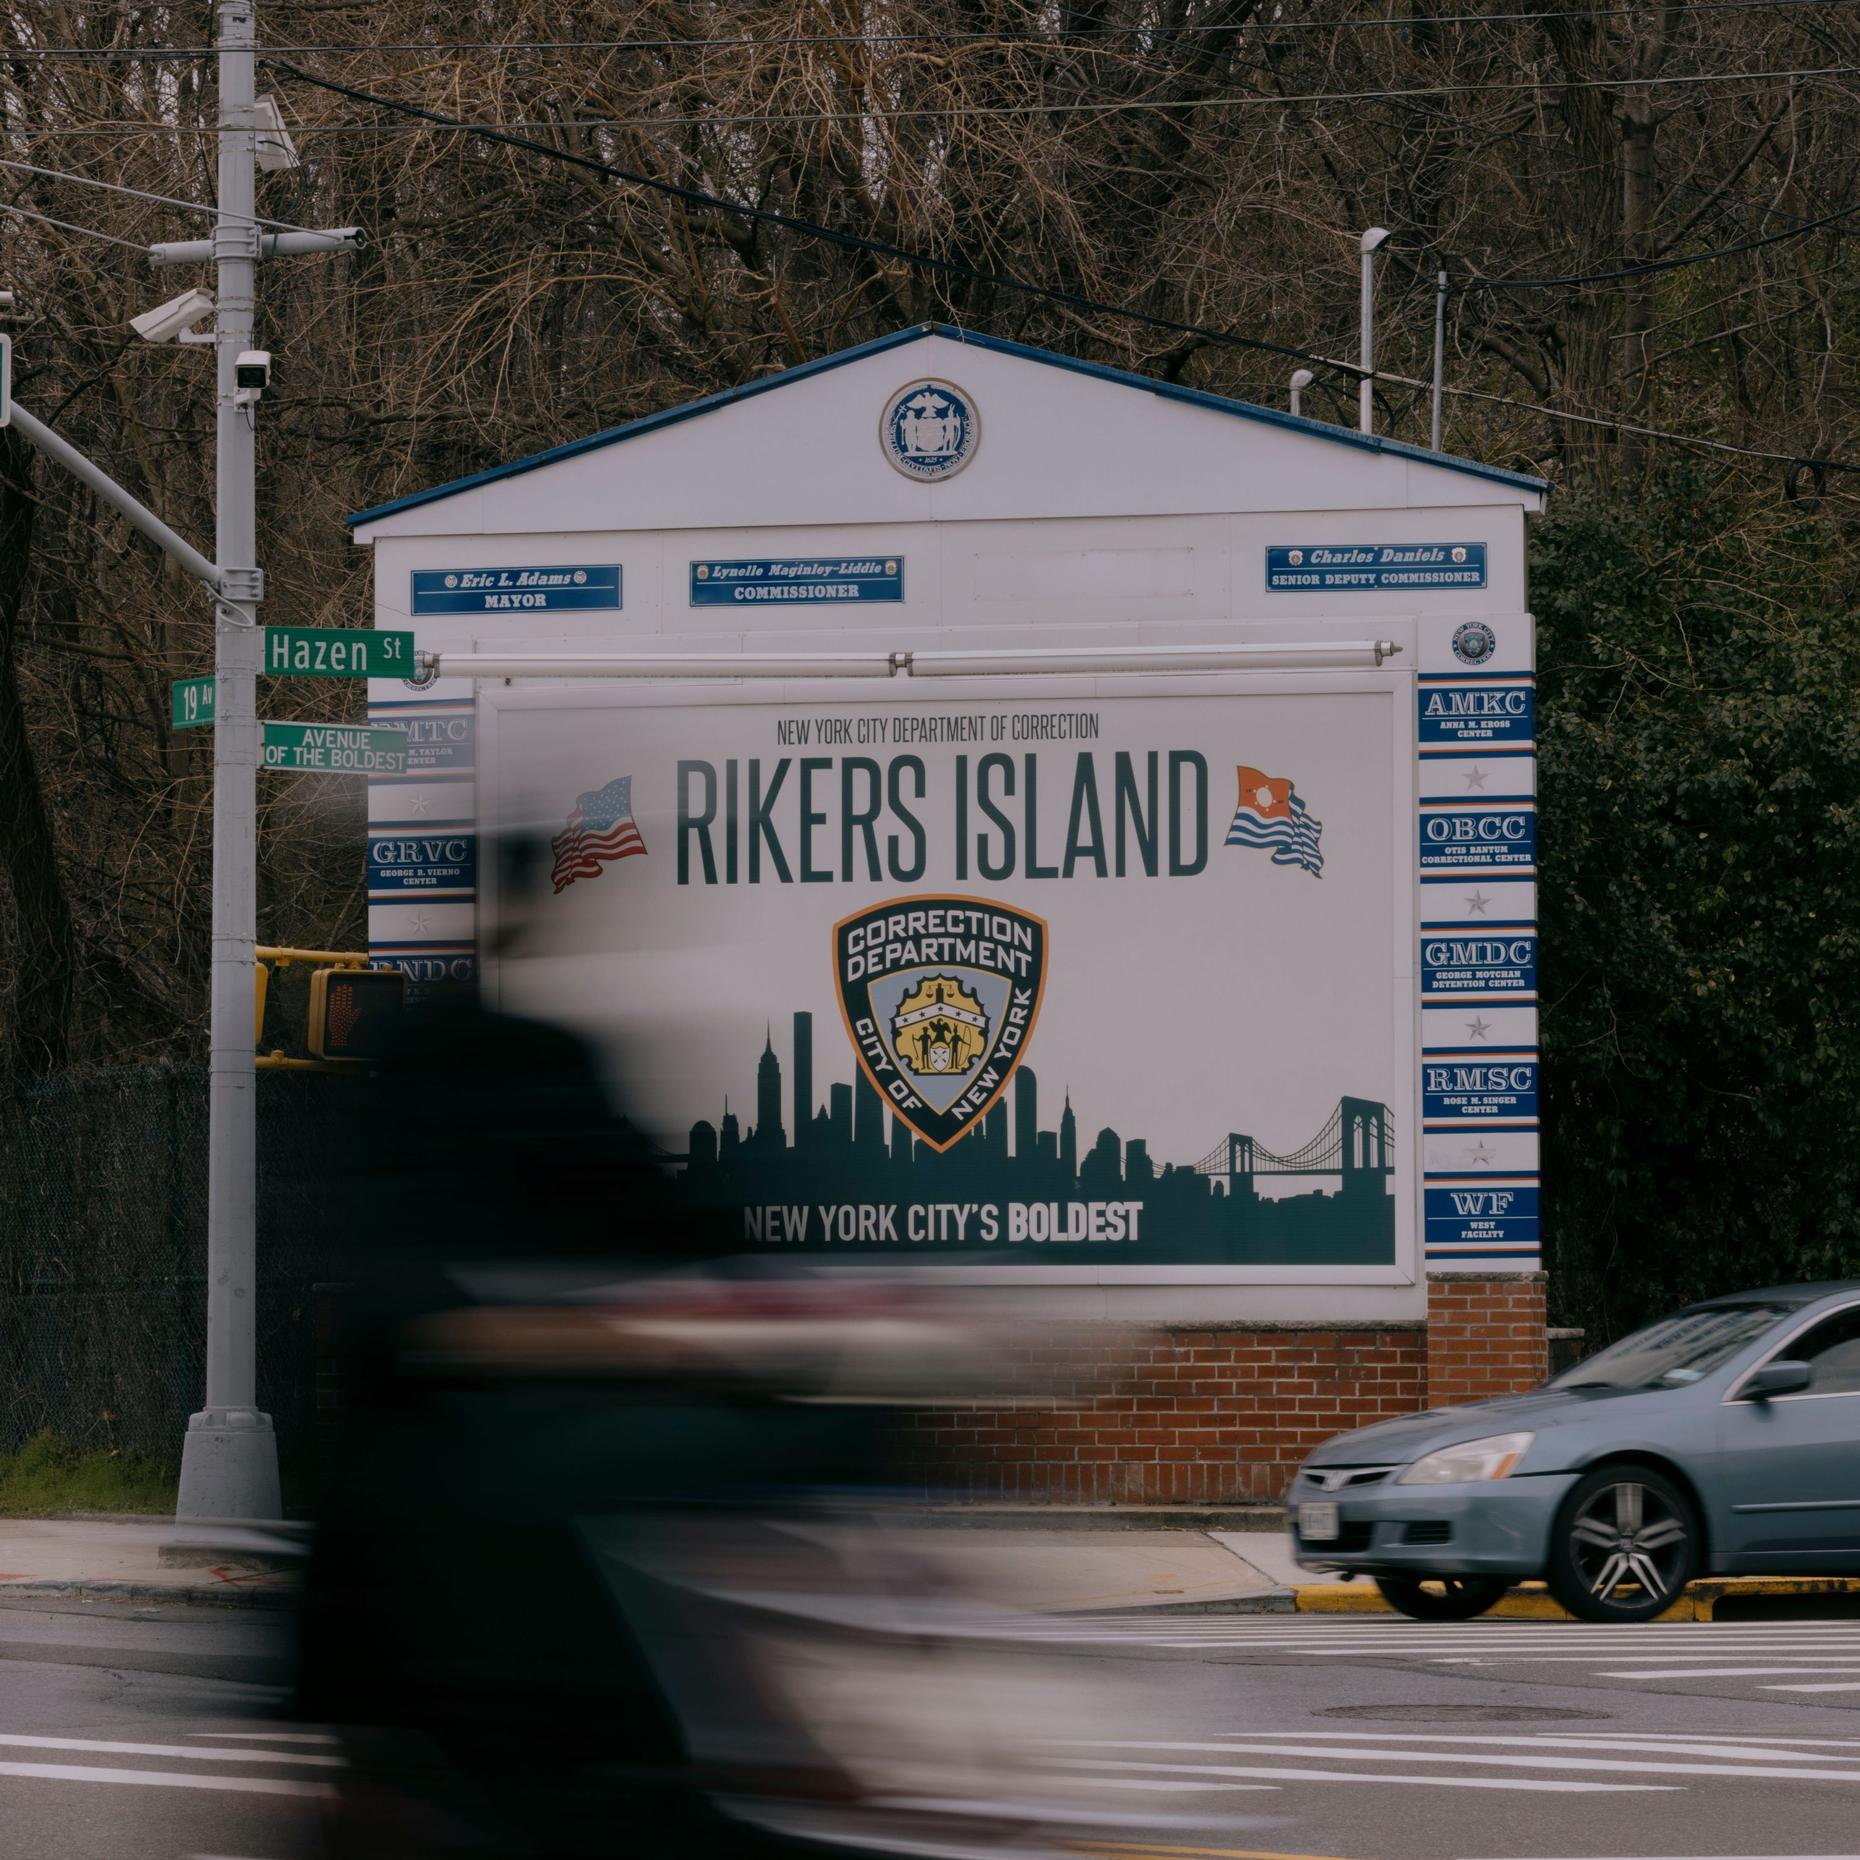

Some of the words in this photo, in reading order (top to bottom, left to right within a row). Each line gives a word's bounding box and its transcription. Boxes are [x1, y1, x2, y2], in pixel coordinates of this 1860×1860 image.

[1310, 549, 1374, 564] Charles
[1380, 548, 1445, 563] Daniels
[460, 574, 494, 587] Eric
[498, 573, 513, 587] L.
[516, 571, 571, 586] Adams
[712, 566, 763, 580] Lynelle
[1272, 574, 1320, 586] SENIOR
[1325, 573, 1376, 585] DEPUTY
[1381, 571, 1480, 584] COMMISSIONER
[734, 585, 859, 600] COMMISSIONER
[484, 594, 547, 608] MAYOR
[272, 634, 367, 671] Hazen
[383, 637, 402, 659] St
[183, 686, 197, 720] 19
[202, 684, 212, 705] Av
[1424, 690, 1526, 716] AMKC
[370, 719, 467, 742] MTC
[777, 720, 810, 745] NEW
[815, 719, 853, 744] YORK
[857, 718, 888, 743] CITY
[893, 715, 986, 743] DEPARTMENT
[990, 715, 1008, 741] OF
[1012, 713, 1099, 740] CORRECTION
[1440, 721, 1465, 729] ANNA
[1468, 721, 1479, 729] M.
[1480, 720, 1510, 728] KROSS
[302, 729, 371, 750] AVENUE
[266, 746, 288, 764] OF
[293, 747, 325, 767] THE
[331, 749, 406, 770] BOLDEST
[408, 757, 437, 765] ENTER
[677, 753, 926, 885] RIKERS
[955, 750, 1209, 881] ISLAND
[1426, 815, 1526, 841] OBCC
[372, 839, 468, 863] GRVC
[1445, 846, 1467, 854] OTIS
[1470, 845, 1508, 854] BANTUM
[1421, 855, 1492, 864] CORRECTIONAL
[1495, 854, 1532, 862] CENTER
[380, 868, 414, 877] GEORGE
[427, 867, 460, 876] VIERNO
[403, 877, 437, 885] CENTER
[847, 909, 1032, 955] CORRECTION
[847, 937, 1032, 983] DEPARTMENT
[1425, 941, 1532, 966] GMDC
[1436, 971, 1473, 979] GEORGE
[1475, 970, 1521, 978] MOTCHAN
[1432, 980, 1486, 988] DETENTION
[1488, 979, 1525, 987] CENTER
[856, 1017, 893, 1073] CITY
[887, 1079, 923, 1111] OF
[951, 1065, 1000, 1121] NEW
[994, 987, 1032, 1060] YORK
[1426, 1067, 1532, 1091] RMSC
[1443, 1097, 1468, 1105] ROSE
[1471, 1097, 1482, 1105] M.
[1483, 1096, 1517, 1104] SINGER
[1461, 1105, 1498, 1113] CENTER
[1450, 1192, 1514, 1216] WF
[744, 1205, 809, 1242] NEW
[819, 1204, 898, 1242] YORK
[908, 1203, 999, 1242] CITY'S
[1008, 1201, 1143, 1242] BOLDEST
[1470, 1221, 1496, 1229] WEST
[1461, 1230, 1504, 1238] FACILITY
